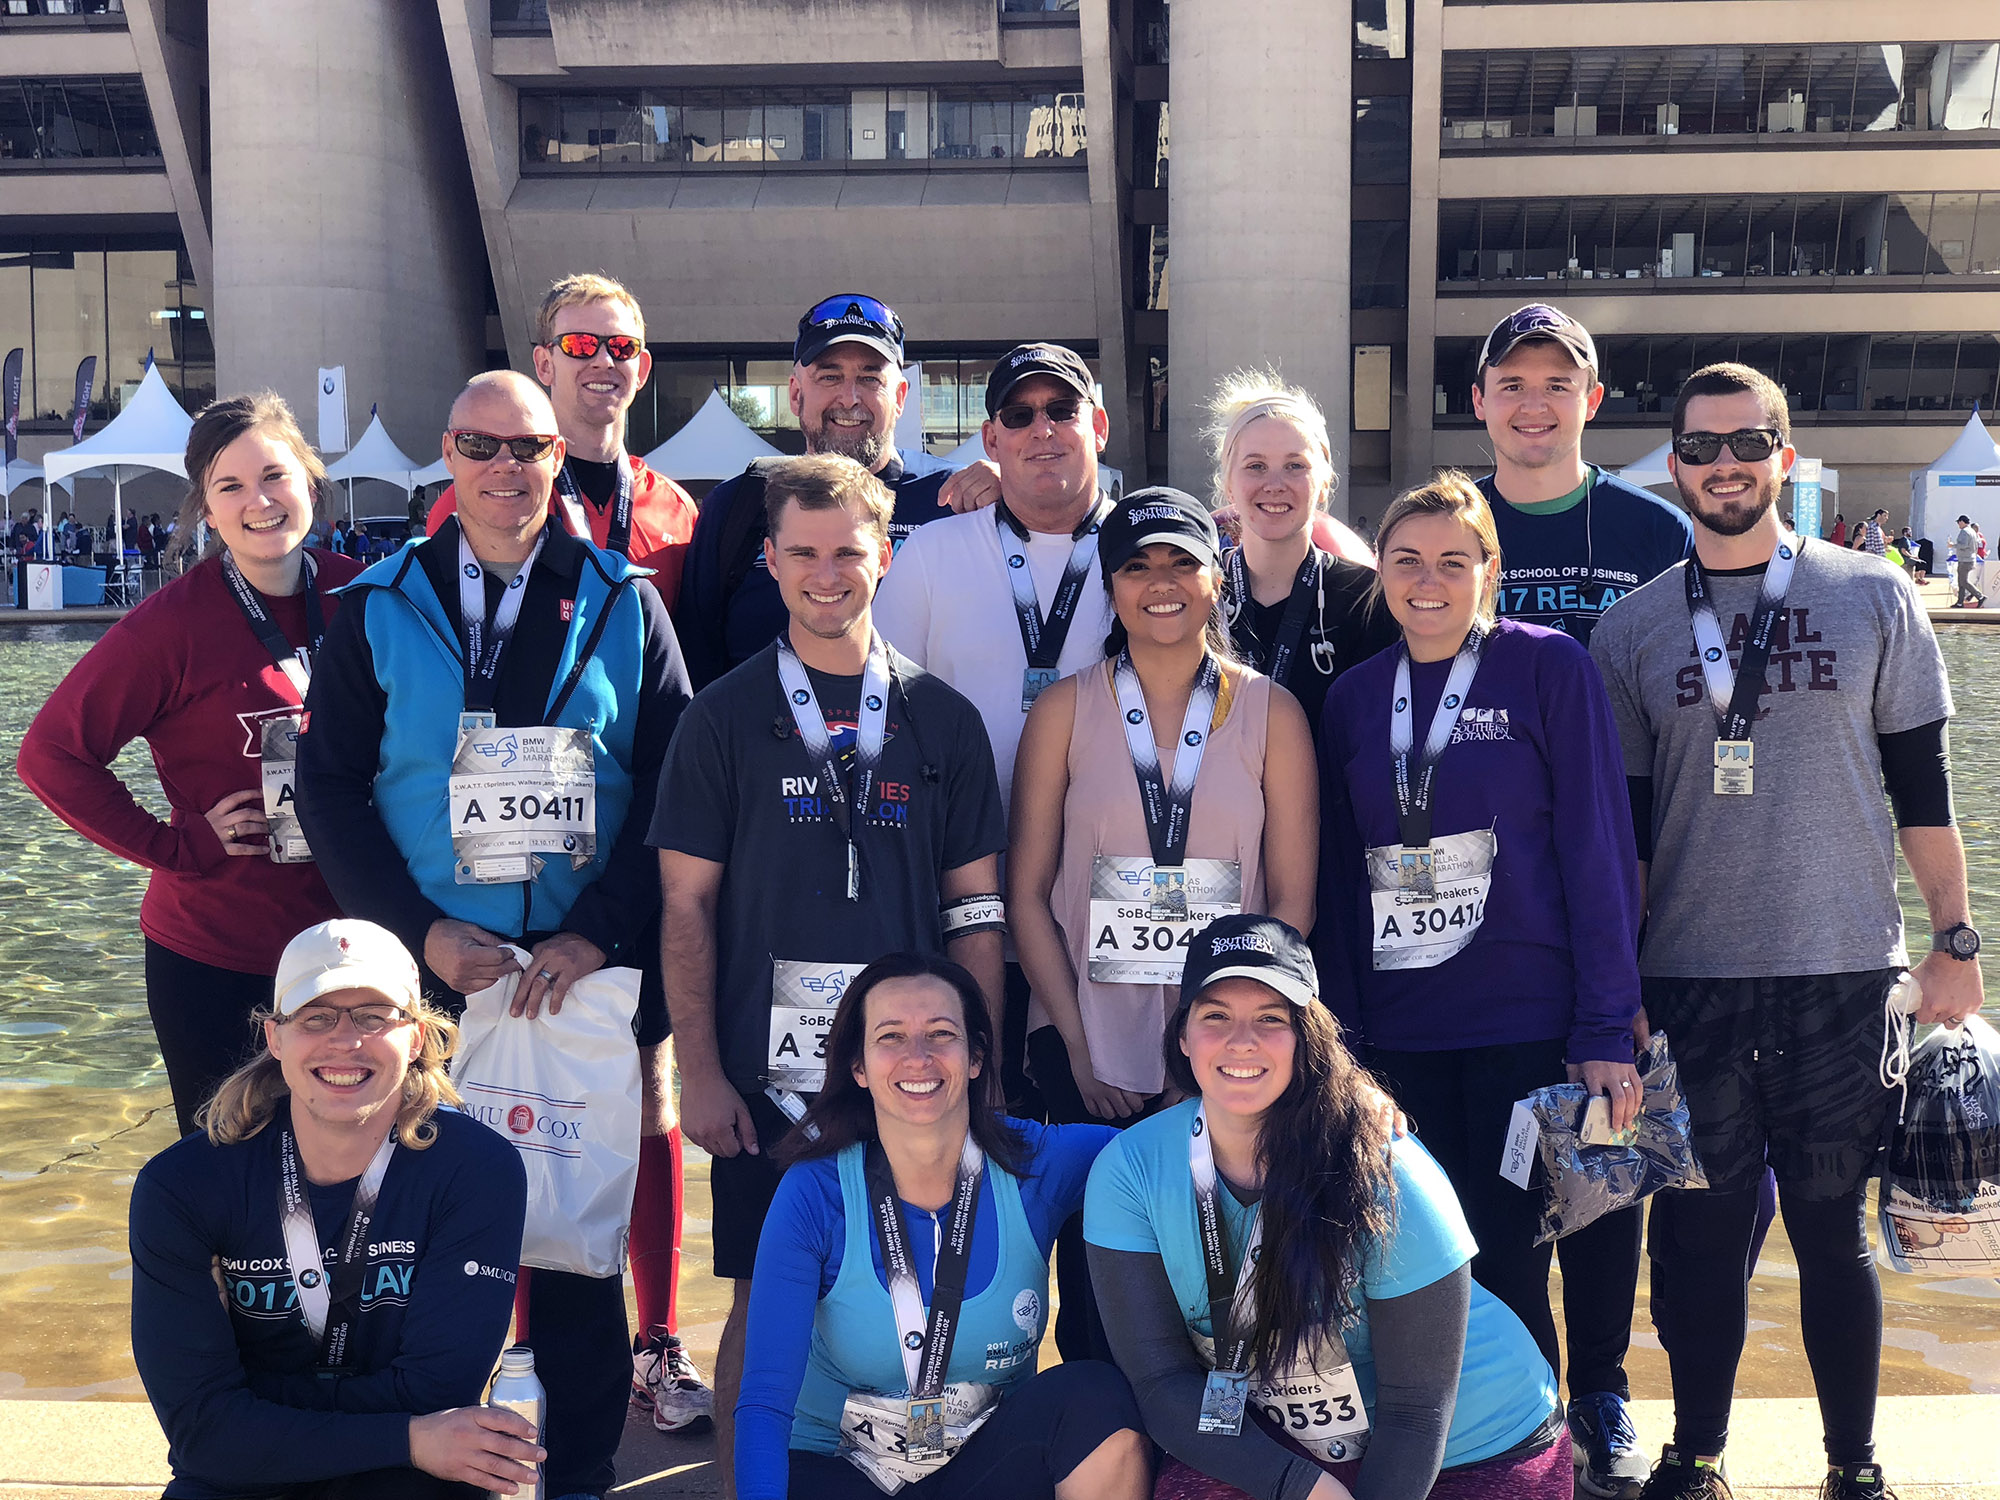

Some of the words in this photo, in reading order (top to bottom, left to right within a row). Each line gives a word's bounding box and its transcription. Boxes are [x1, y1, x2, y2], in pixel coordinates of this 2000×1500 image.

[80, 381, 91, 408] LIGHT
[1128, 507, 1181, 517] SOUTHERN
[1800, 488, 1808, 518] PARTY
[889, 523, 921, 532] SINES
[1510, 568, 1560, 578] SCHOOL
[1562, 567, 1578, 577] OF
[1496, 588, 1528, 612] 17
[1537, 585, 1629, 611] RELA
[522, 738, 545, 746] BMW
[276, 783, 295, 807] A
[484, 778, 517, 789] (Sprinters,
[518, 779, 542, 787] Walkers
[782, 777, 818, 796] RIV
[877, 782, 910, 801] IES
[1421, 791, 1429, 811] RELAY
[1425, 765, 1434, 791] FINISHER
[462, 799, 487, 824] A
[499, 795, 584, 821] 30411
[861, 794, 870, 815] RELAY
[1434, 854, 1458, 864] ALLAS
[1187, 886, 1217, 894] ATHON
[1435, 886, 1480, 901] neakers
[1190, 910, 1216, 921] kers
[1380, 915, 1402, 939] A
[1095, 925, 1119, 949] A
[1132, 926, 1194, 951] 304
[1211, 943, 1276, 956] BOTANICAL
[1212, 936, 1271, 947] SOUTHERN
[776, 1033, 800, 1057] A
[462, 1102, 503, 1126] SMU
[537, 1115, 582, 1140] COX
[1522, 1120, 1531, 1150] MARATHON
[282, 1131, 290, 1176] MARATHON
[288, 1154, 297, 1173] BMW
[284, 1175, 295, 1213] WEEKEND
[291, 1173, 301, 1204] DALLAS
[957, 1181, 968, 1212] DALLAS
[1974, 1185, 1997, 1199] BAG
[352, 1211, 363, 1236] RELAY
[880, 1203, 891, 1232] DALLAS
[885, 1195, 898, 1232] WEEKEND
[954, 1212, 962, 1229] BMW
[956, 1213, 968, 1255] MARATHON
[964, 1175, 975, 1213] WEEKEND
[1202, 1201, 1211, 1231] DALLAS
[1206, 1192, 1217, 1235] WEEKEND
[345, 1233, 357, 1264] FINISHER
[885, 1235, 894, 1252] BMW
[951, 1229, 959, 1247] 2017
[1205, 1232, 1213, 1251] BMW
[250, 1258, 283, 1271] COX
[368, 1241, 416, 1257] SINESS
[890, 1252, 900, 1270] 2017
[892, 1232, 908, 1275] MARATHON
[1208, 1250, 1217, 1270] 2017
[1212, 1235, 1224, 1275] MARATHON
[360, 1264, 416, 1300] LAY
[337, 1322, 348, 1356] WEEKEND
[931, 1310, 944, 1353] MARATHON
[941, 1319, 950, 1336] 2017
[330, 1326, 340, 1354] DALLAS
[938, 1336, 947, 1354] BMW
[986, 1341, 1009, 1350] 2017
[1231, 1340, 1245, 1369] FINISHER
[923, 1352, 936, 1391] WEEKEND
[931, 1353, 943, 1385] DALLAS
[946, 1397, 968, 1408] LLAS
[1263, 1383, 1322, 1399] Striders
[1262, 1394, 1357, 1430] 0533
[853, 1420, 876, 1443] A
[1859, 1469, 1874, 1477] NIKE
